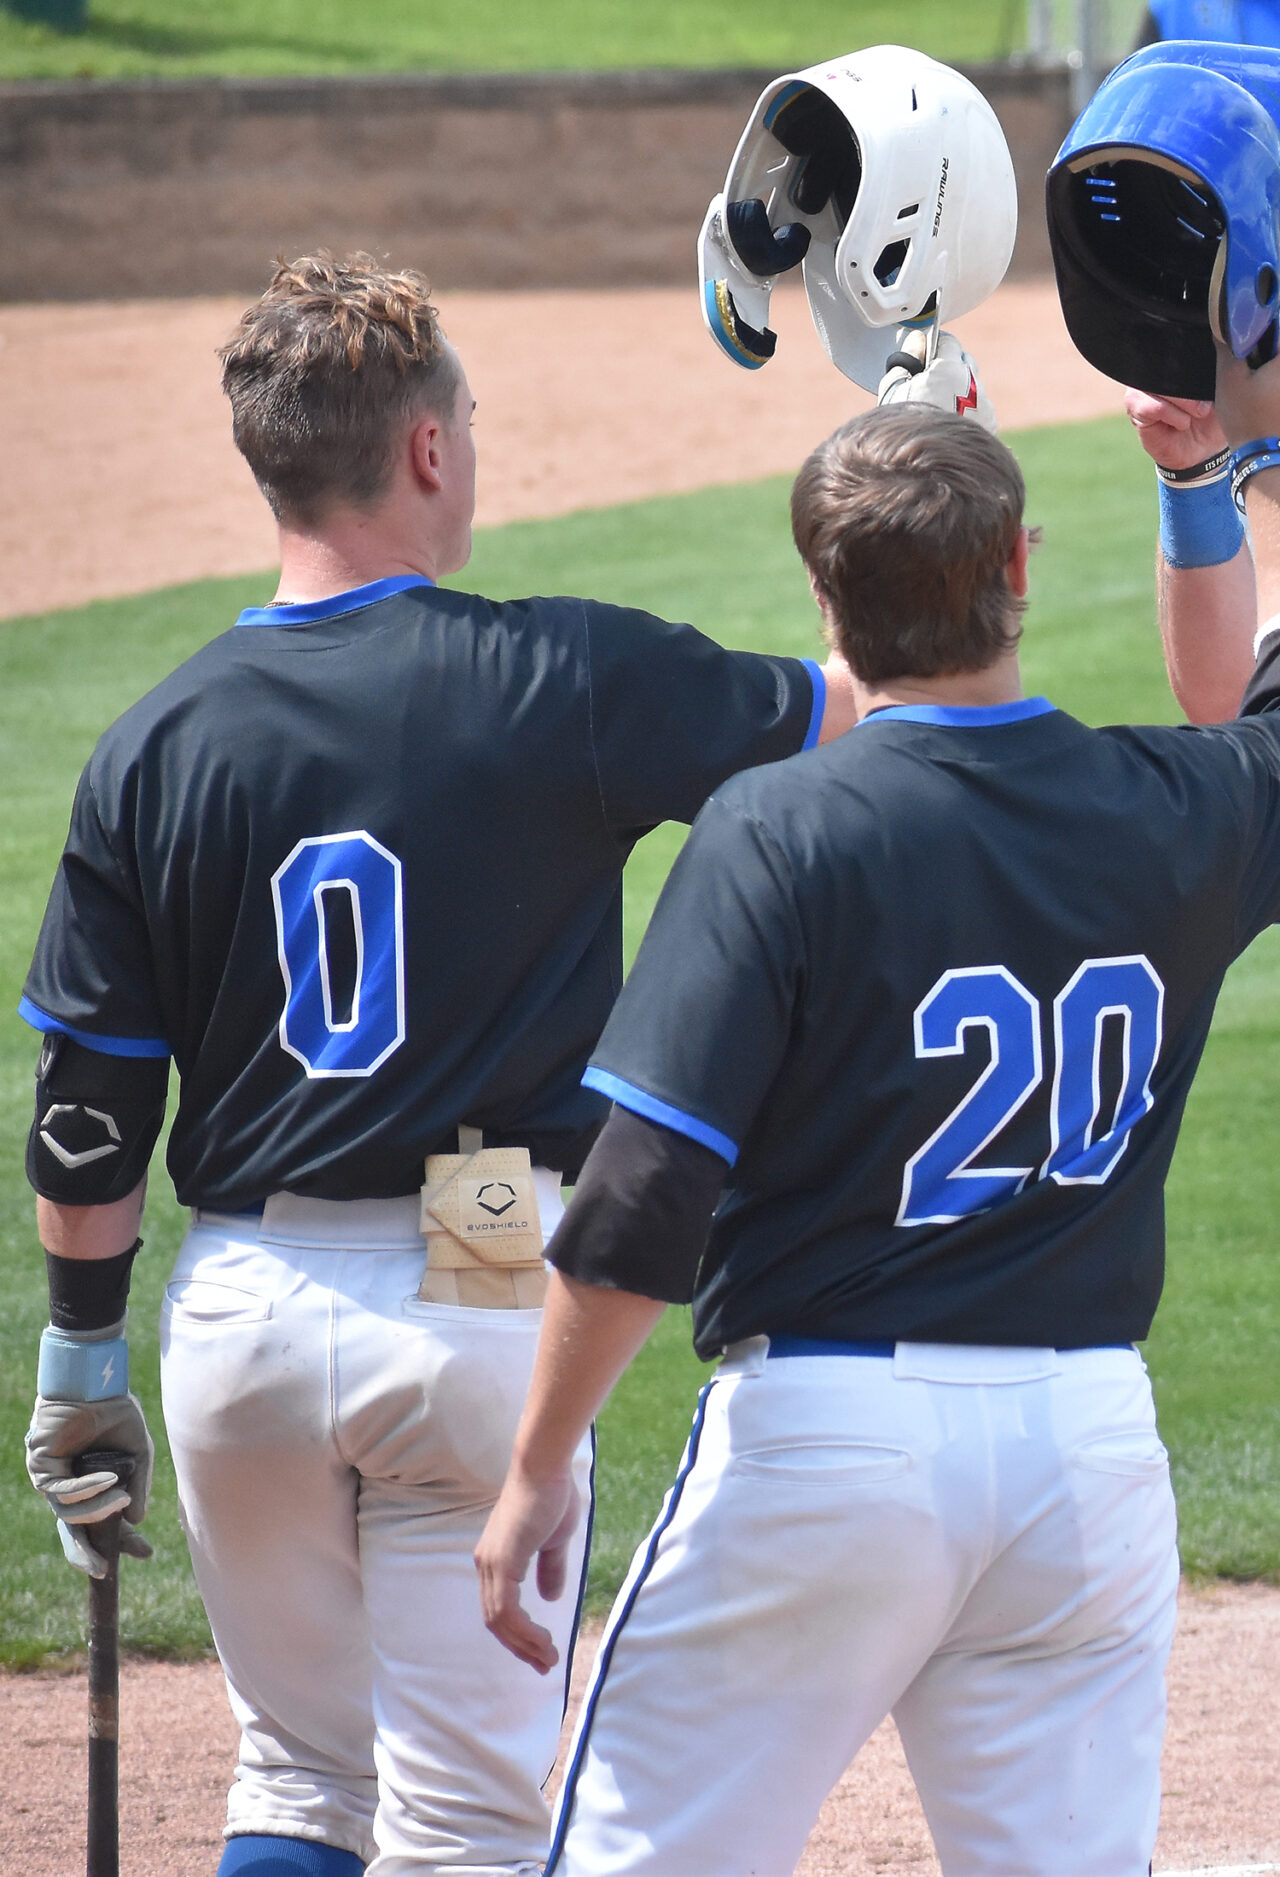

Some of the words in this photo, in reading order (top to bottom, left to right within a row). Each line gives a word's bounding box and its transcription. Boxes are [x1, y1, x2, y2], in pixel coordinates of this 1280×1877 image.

[932, 157, 949, 238] RAWLINGS
[270, 829, 405, 1078] 0
[894, 954, 1165, 1227] 20
[467, 1221, 528, 1231] EVOSHIELD
